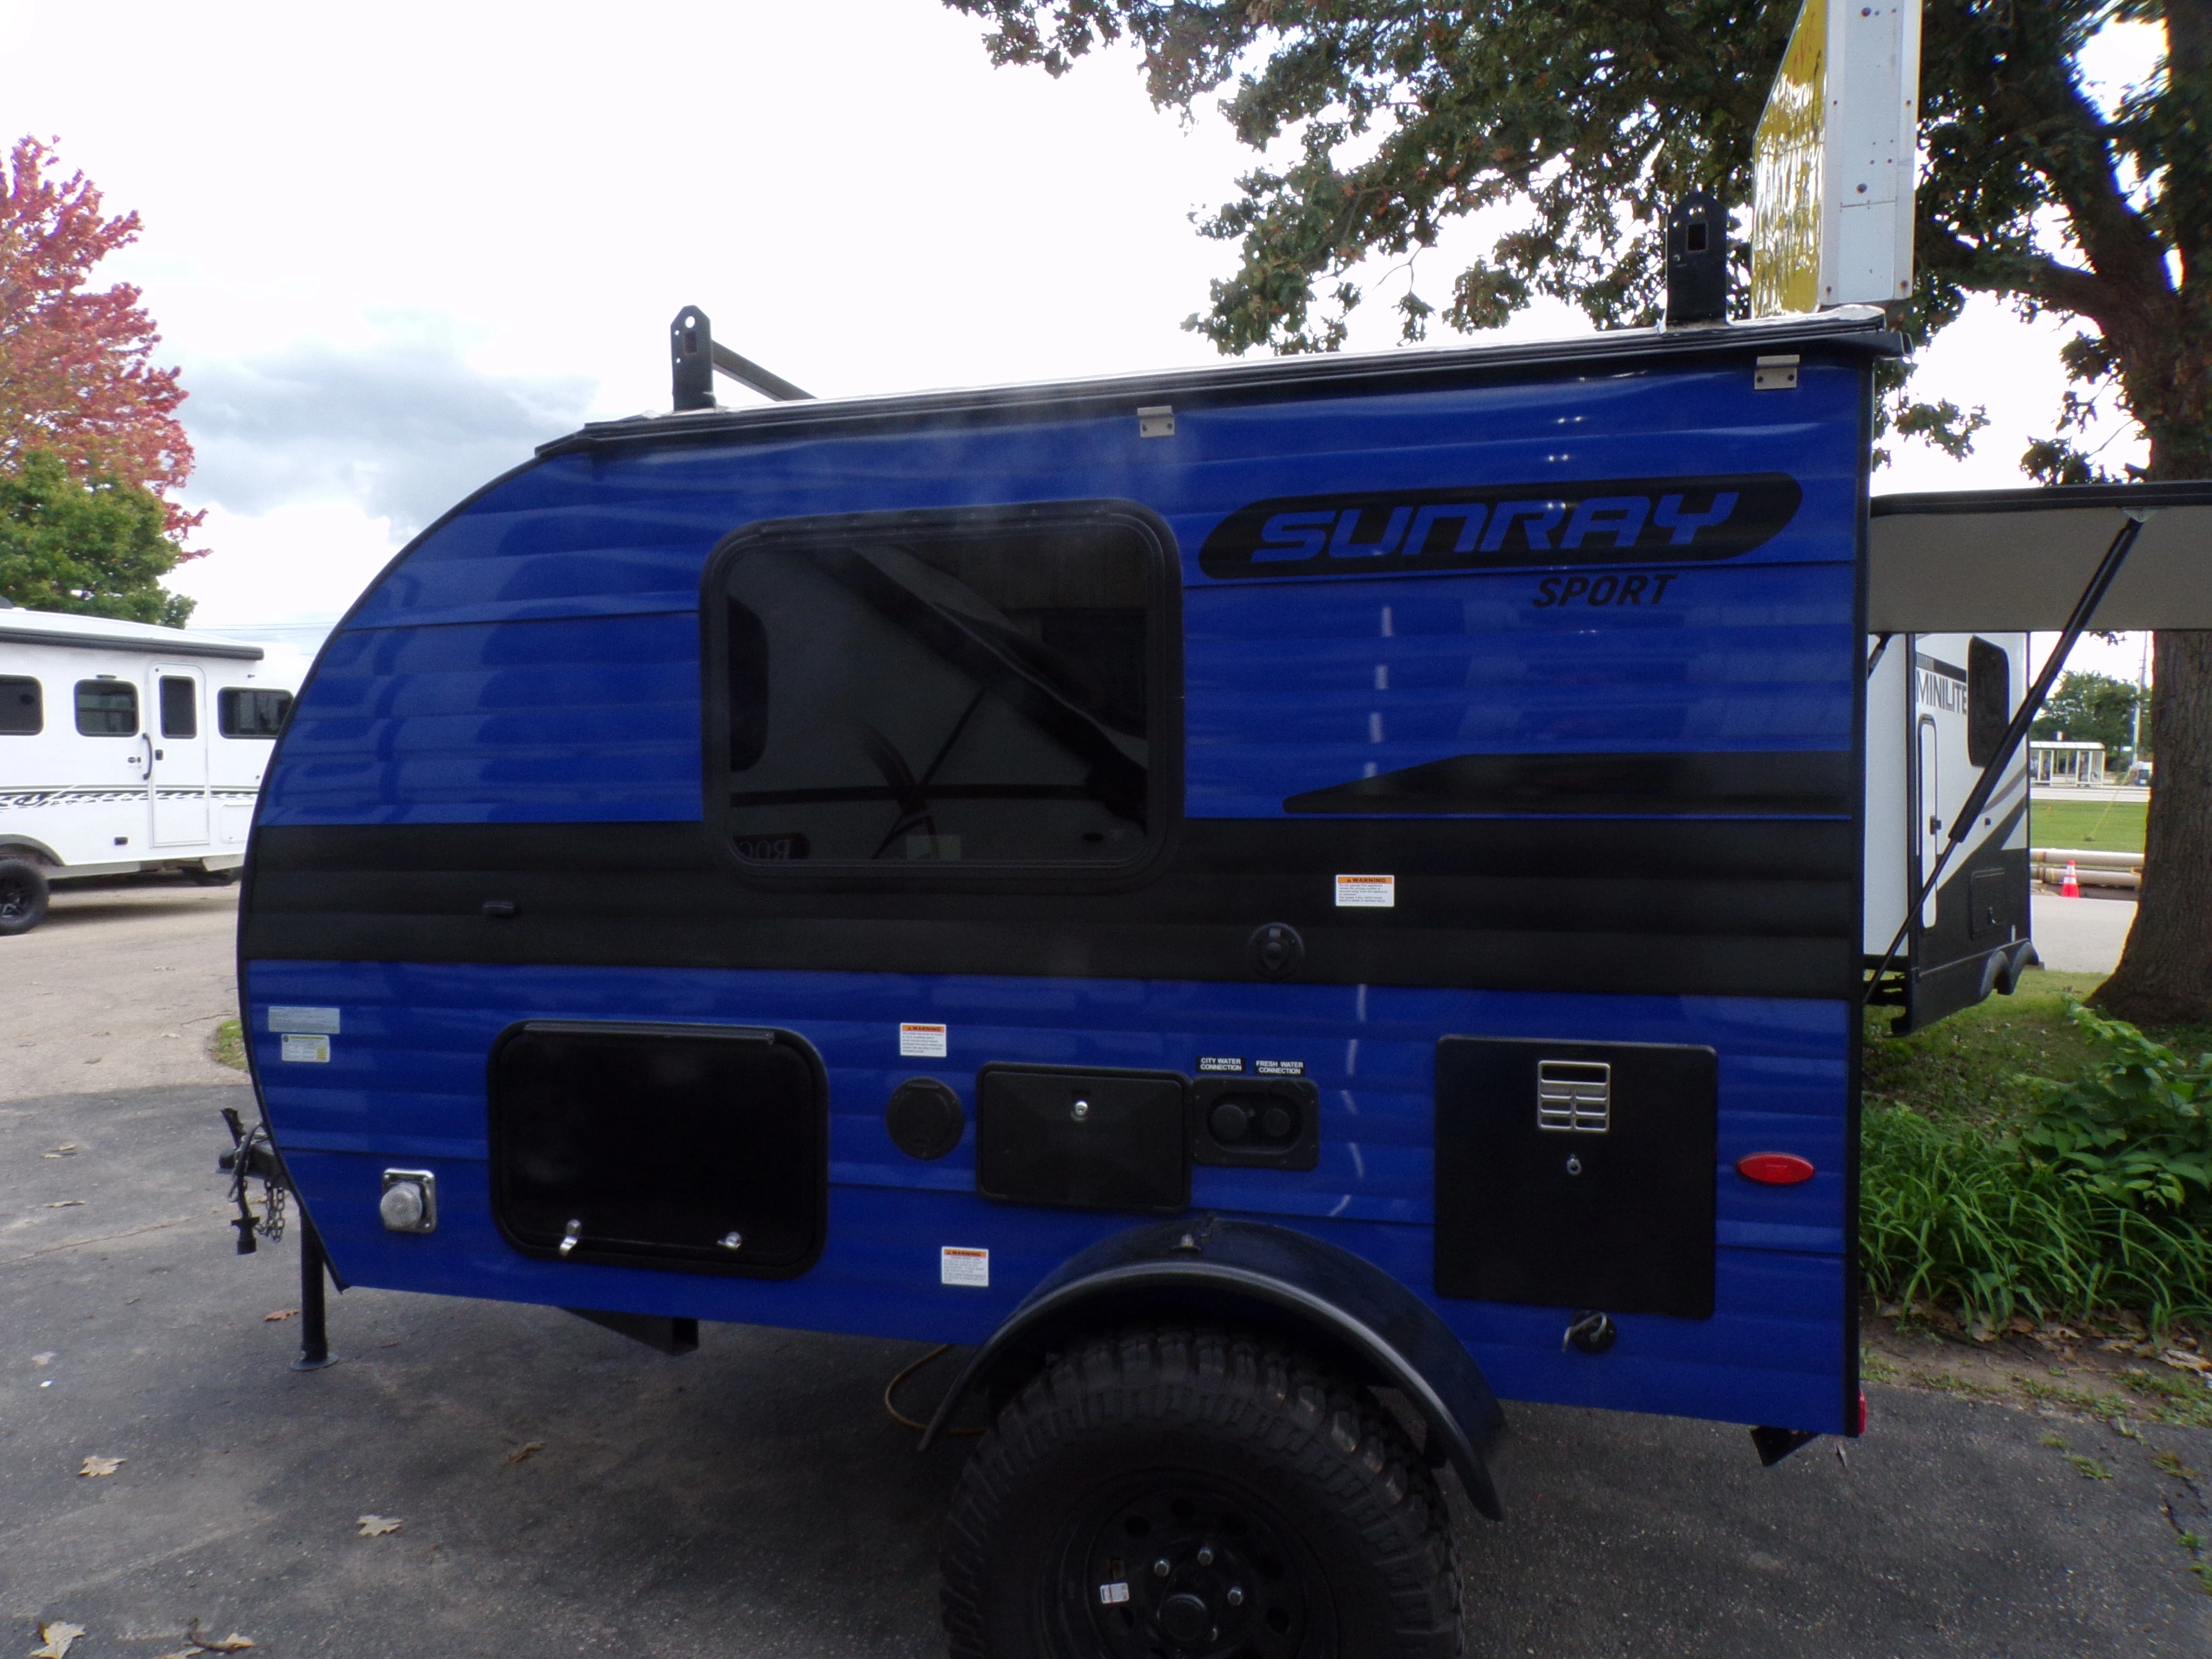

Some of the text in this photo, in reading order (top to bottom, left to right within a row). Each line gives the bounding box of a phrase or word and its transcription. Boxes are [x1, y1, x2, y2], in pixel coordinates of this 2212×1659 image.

[1250, 491, 1740, 563] SUNRAY
[1532, 575, 1677, 608] SPORT
[1915, 670, 1967, 715] MINILITE
